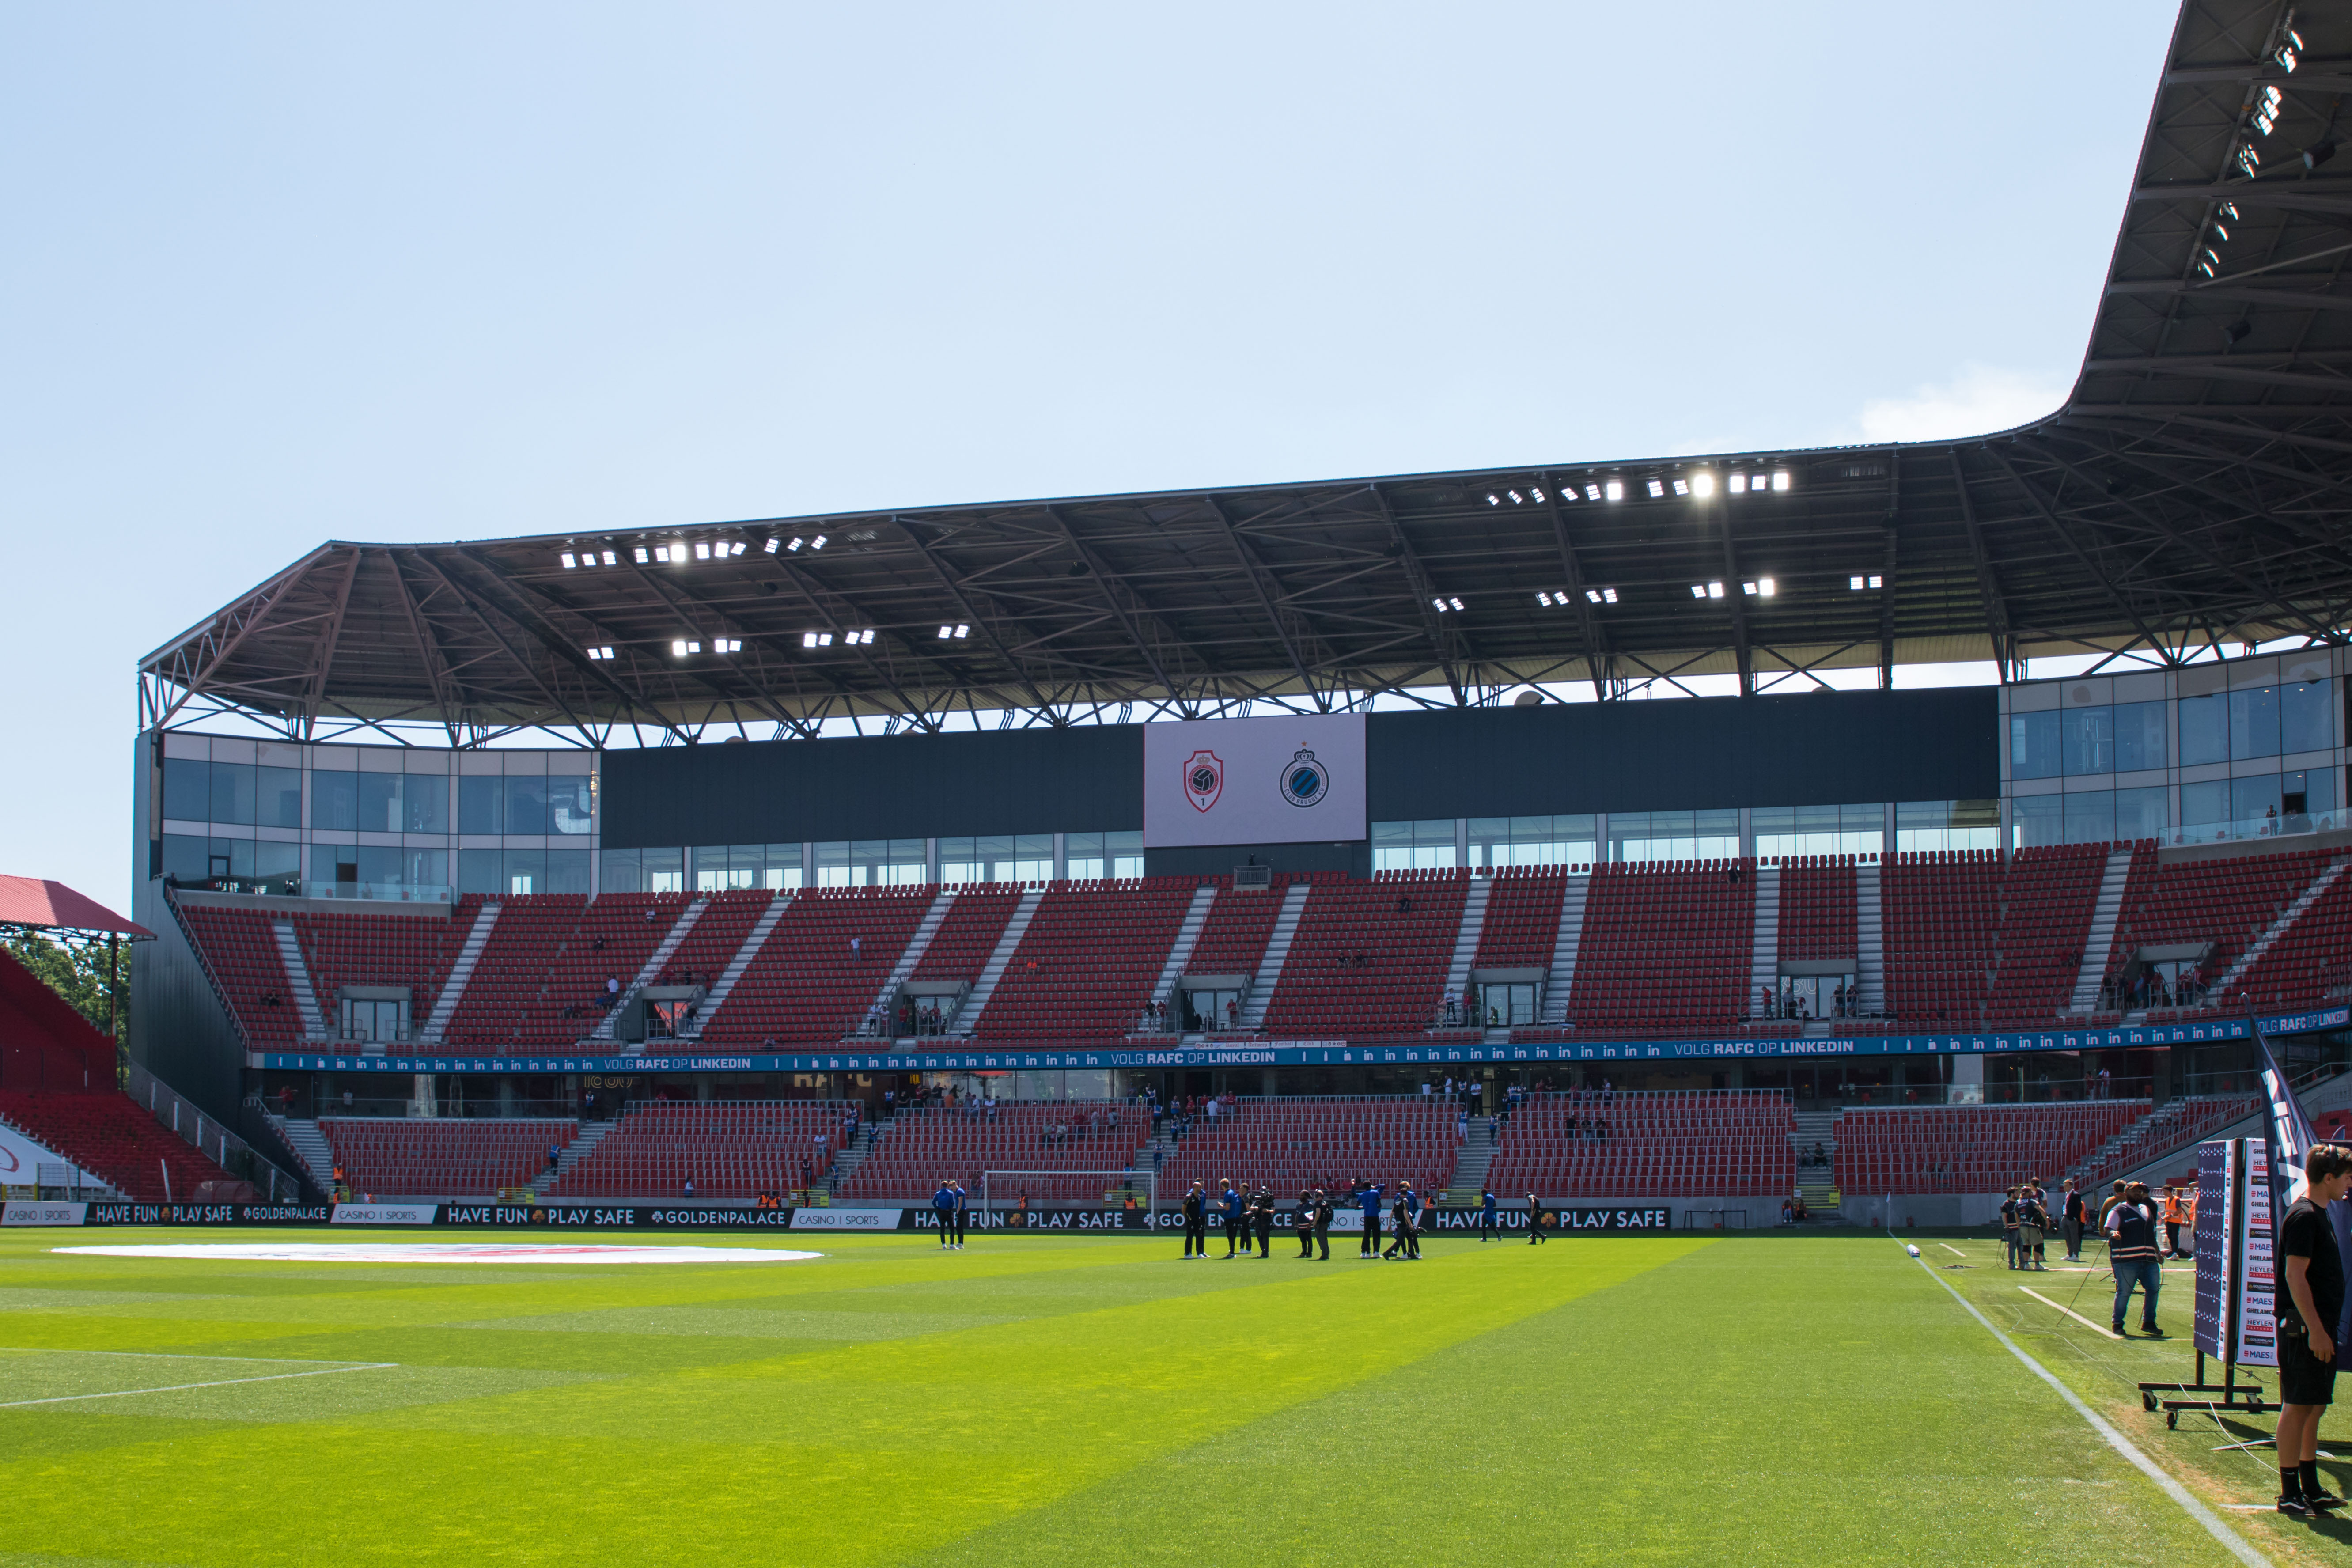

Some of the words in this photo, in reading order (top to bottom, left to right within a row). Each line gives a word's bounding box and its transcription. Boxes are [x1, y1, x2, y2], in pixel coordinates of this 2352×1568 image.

[1284, 788, 1296, 802] CLUB
[1296, 795, 1319, 805] BRUGGE
[2256, 1020, 2277, 1033] OLG
[2280, 1016, 2307, 1031] RAFC
[2308, 1015, 2318, 1028] OP
[1974, 1038, 1984, 1049] in
[1997, 1038, 2007, 1048] in
[2020, 1037, 2031, 1047] in
[2041, 1036, 2053, 1047] in
[2065, 1035, 2076, 1046] in
[2087, 1034, 2098, 1045] in
[2110, 1033, 2121, 1043] in
[2131, 1031, 2142, 1042] in
[2154, 1030, 2164, 1041] in
[2174, 1029, 2184, 1040] in
[2194, 1027, 2204, 1038] in
[2213, 1026, 2223, 1037] in
[2233, 1024, 2242, 1035] in
[1386, 1050, 1395, 1060] in
[1407, 1049, 1417, 1060] in
[1429, 1049, 1439, 1059] in
[1449, 1049, 1460, 1059] in
[1471, 1048, 1482, 1059] in
[1493, 1048, 1504, 1058] in
[1515, 1047, 1526, 1058] in
[1537, 1047, 1548, 1057] in
[1559, 1047, 1570, 1057] in
[1582, 1046, 1593, 1057] in
[1604, 1046, 1615, 1057] in
[1625, 1045, 1637, 1056] in
[1648, 1045, 1659, 1055] in
[1674, 1044, 1710, 1055] VOLG
[1714, 1043, 1754, 1054] RAFC
[1759, 1043, 1777, 1053] OP
[1781, 1041, 1854, 1053] LINKEDIN
[357, 1059, 366, 1068] in
[377, 1060, 386, 1069] in
[397, 1060, 407, 1069] in
[416, 1060, 425, 1069] in
[436, 1060, 445, 1069] in
[455, 1060, 465, 1070] in
[475, 1060, 484, 1070] in
[493, 1060, 502, 1070] in
[511, 1060, 520, 1070] in
[529, 1060, 538, 1069] in
[547, 1060, 556, 1069] in
[564, 1060, 573, 1069] in
[583, 1060, 591, 1069] in
[605, 1060, 633, 1069] VOLG
[636, 1059, 668, 1069] RAFC
[673, 1059, 687, 1068] OP
[691, 1059, 750, 1068] LINKEDIN
[849, 1057, 858, 1067] in
[869, 1057, 878, 1067] in
[888, 1057, 898, 1067] in
[906, 1057, 916, 1066] in
[926, 1057, 936, 1066] in
[946, 1056, 956, 1066] in
[966, 1056, 976, 1066] in
[986, 1056, 996, 1065] in
[1006, 1055, 1016, 1065] in
[1026, 1055, 1037, 1065] in
[1047, 1055, 1057, 1065] in
[1067, 1055, 1076, 1065] in
[1087, 1054, 1097, 1064] in
[1111, 1054, 1143, 1064] VOLG
[1147, 1053, 1184, 1064] RAFC
[1188, 1053, 1204, 1063] OP
[1208, 1052, 1275, 1063] LINKEDIN
[8, 1210, 37, 1220] CASINO
[45, 1210, 70, 1220] SPORTS
[96, 1206, 129, 1222] HAVE
[134, 1206, 158, 1222] FUN
[173, 1206, 202, 1222] PLAY
[205, 1206, 233, 1221] SAFE
[252, 1207, 326, 1220] GOLDENPALACE
[338, 1211, 375, 1220] CASINO
[386, 1211, 416, 1220] SPORTS
[448, 1208, 490, 1223] HAVE
[496, 1208, 528, 1223] FUN
[548, 1209, 589, 1224] PLAY
[594, 1210, 634, 1224] SAFE
[666, 1212, 784, 1224] GOLDENPALACE
[969, 1212, 1004, 1227] FUN
[1028, 1212, 1073, 1228] PLAY
[1079, 1213, 1123, 1228] SAFE
[1561, 1212, 1610, 1227] PLAY
[1617, 1211, 1666, 1227] SAFE
[799, 1216, 834, 1225] CASINO
[846, 1216, 879, 1225] SPORTS
[2250, 1350, 2270, 1359] MAES
